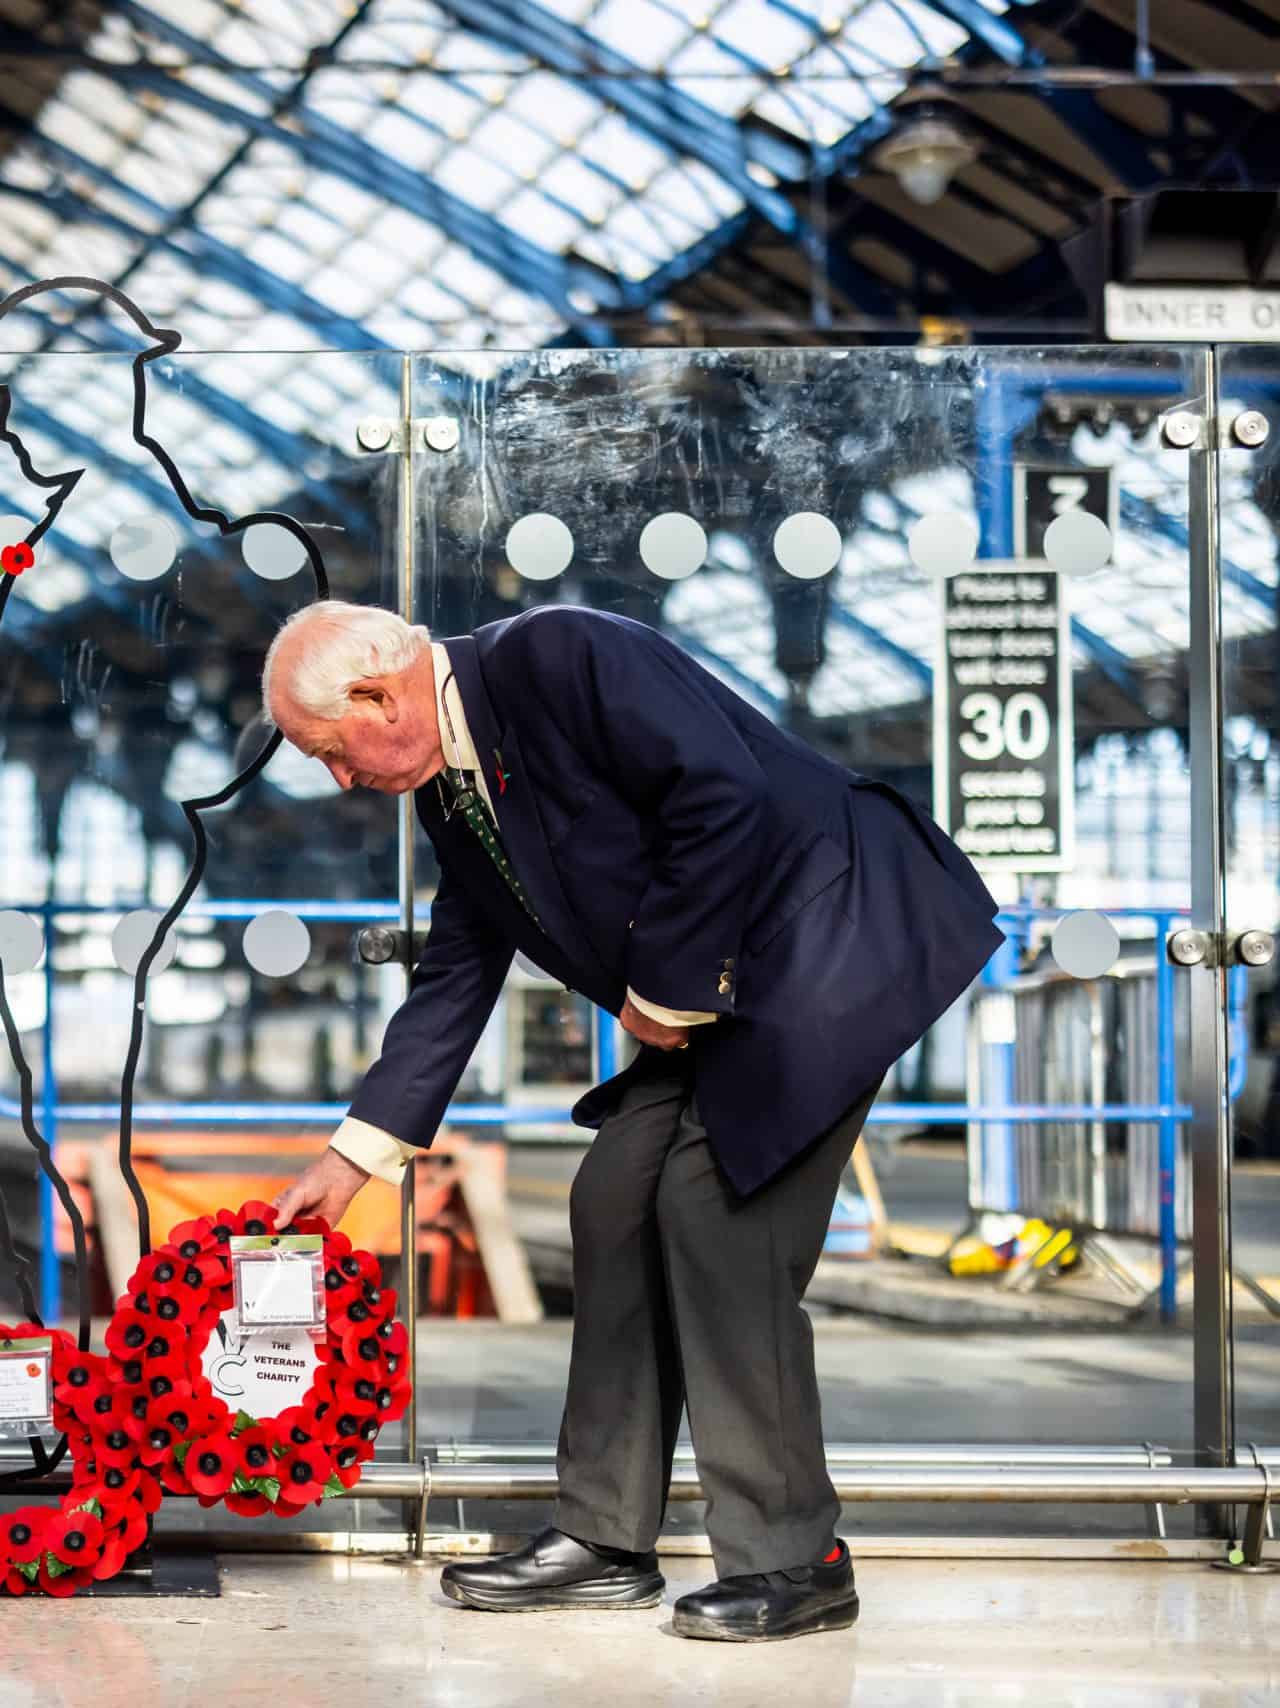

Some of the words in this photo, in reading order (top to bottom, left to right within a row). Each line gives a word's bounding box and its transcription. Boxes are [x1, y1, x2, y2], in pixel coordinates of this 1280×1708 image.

[1124, 301, 1227, 327] INNER
[959, 692, 1050, 761] 30
[271, 1341, 292, 1351] THE
[254, 1355, 306, 1368] VETERANS
[256, 1371, 301, 1383] CHARITY
